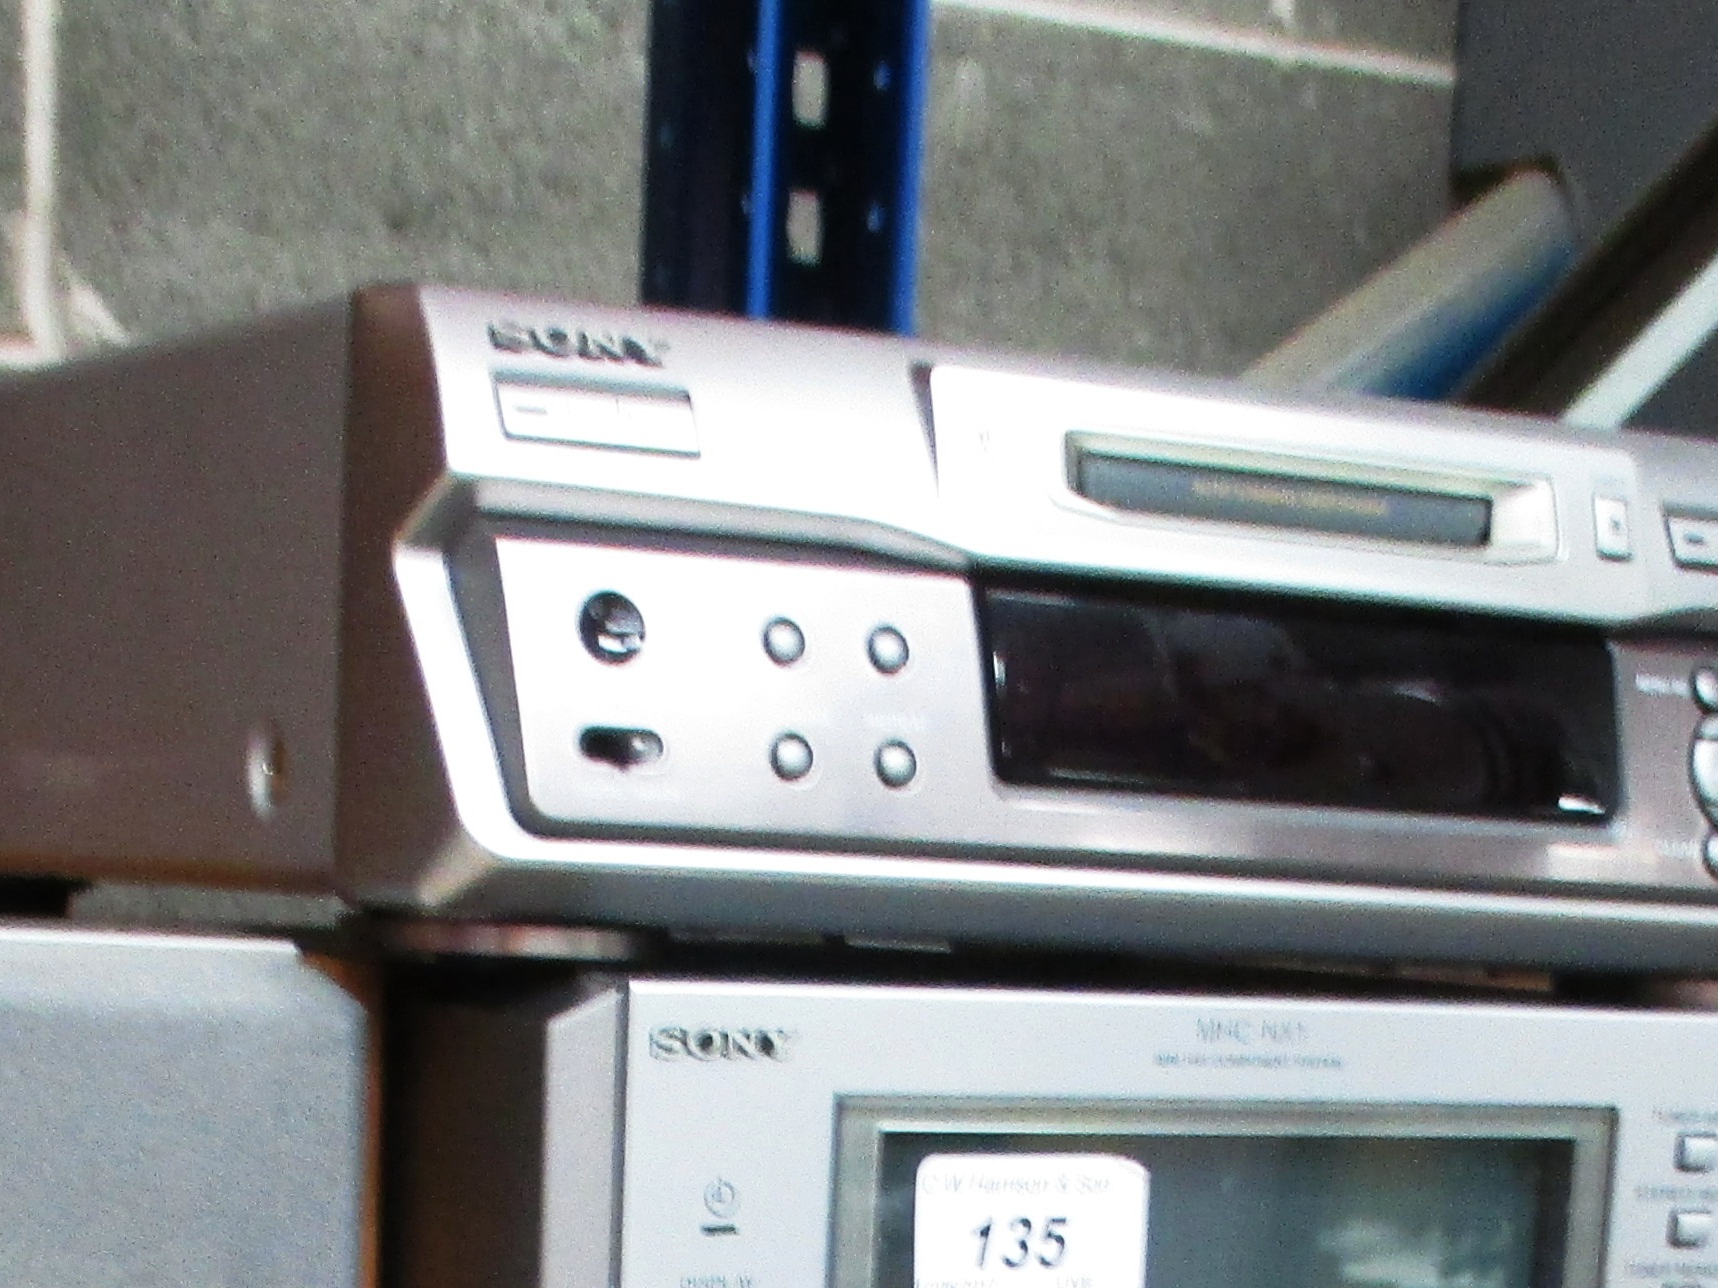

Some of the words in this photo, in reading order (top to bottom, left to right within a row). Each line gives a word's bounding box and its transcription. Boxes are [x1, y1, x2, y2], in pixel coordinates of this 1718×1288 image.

[487, 322, 670, 368] SONY
[649, 1025, 800, 1062] SONY
[970, 1214, 1072, 1271] 135
